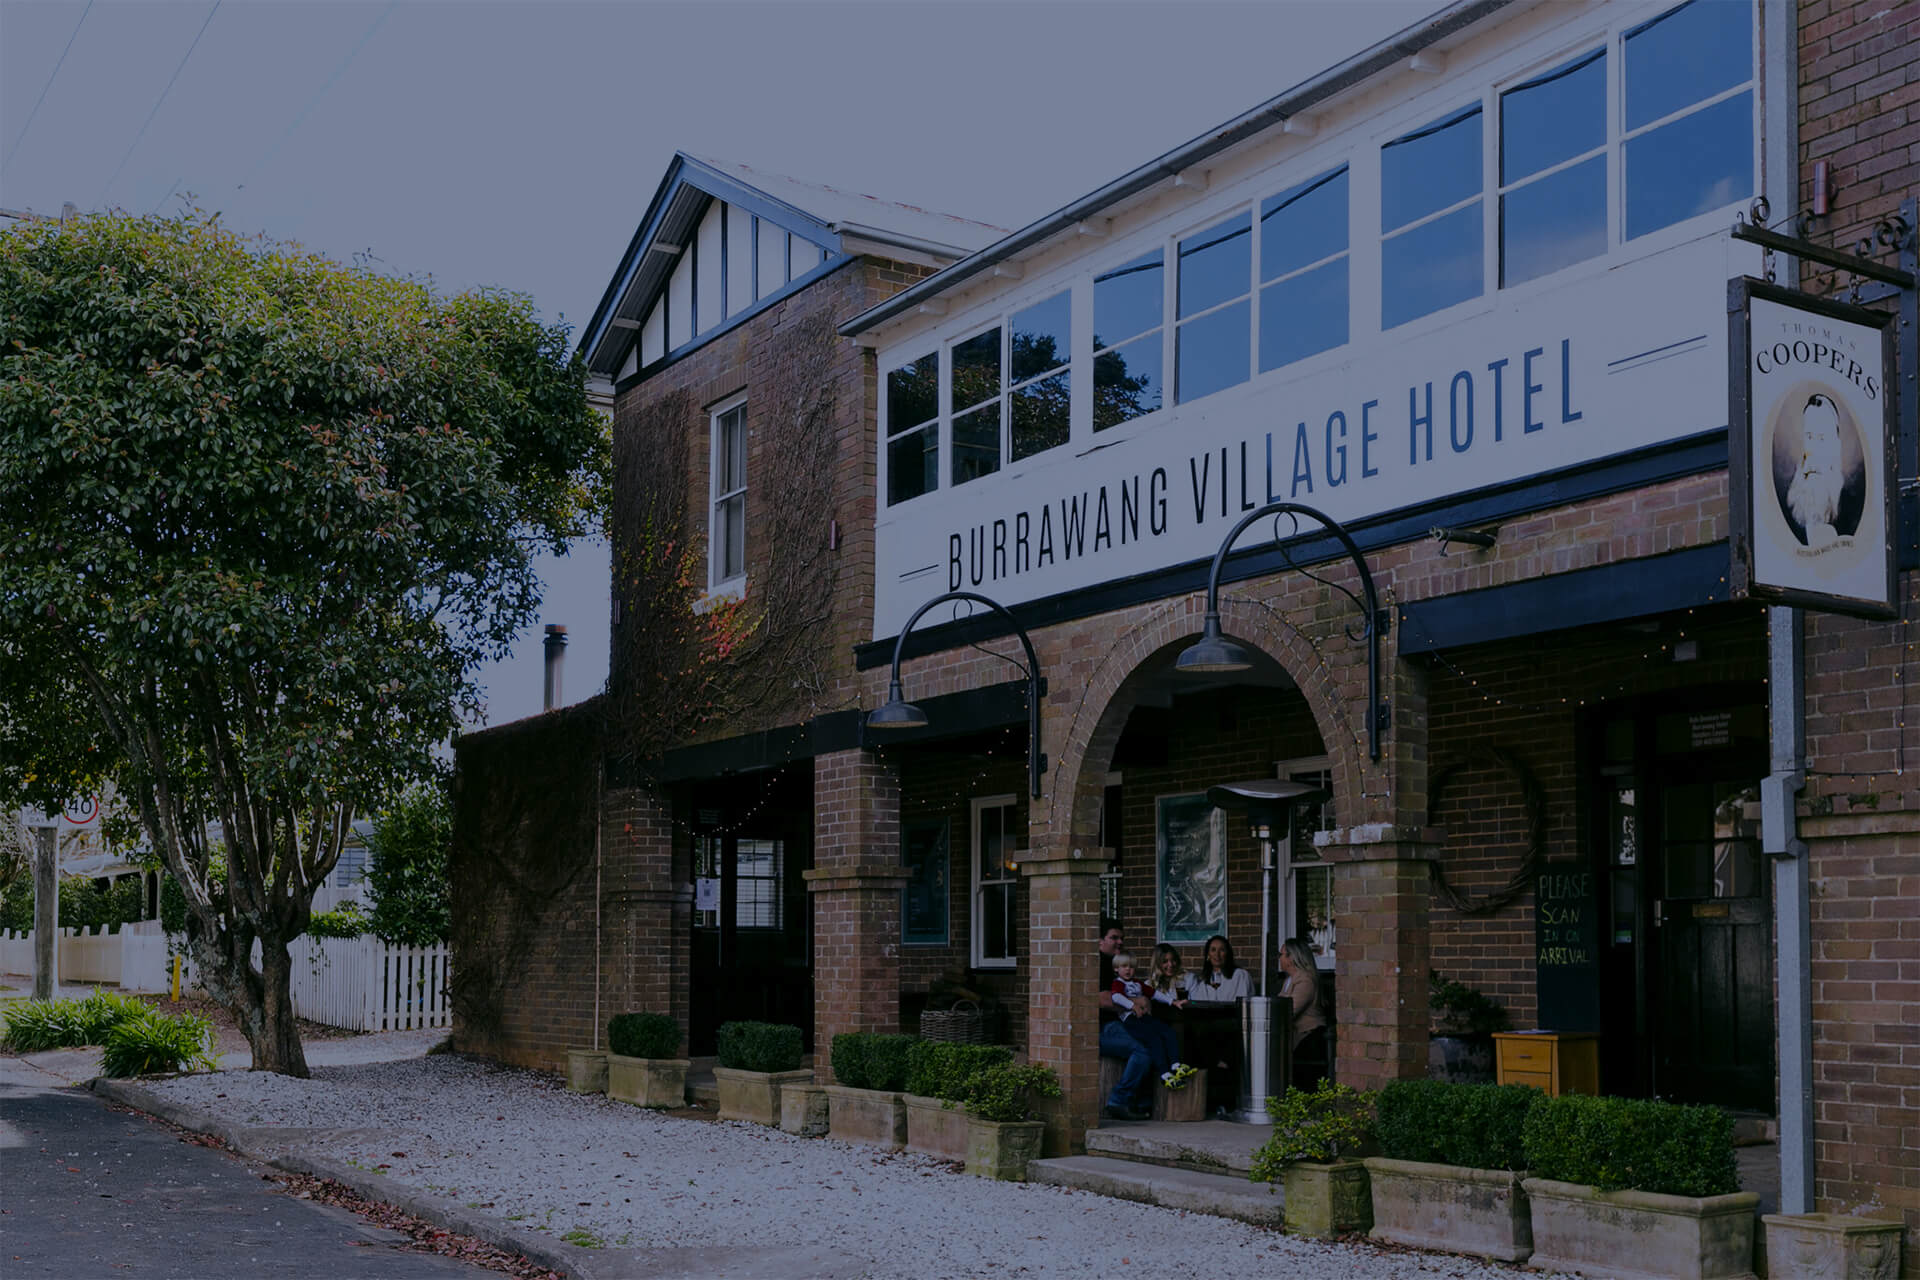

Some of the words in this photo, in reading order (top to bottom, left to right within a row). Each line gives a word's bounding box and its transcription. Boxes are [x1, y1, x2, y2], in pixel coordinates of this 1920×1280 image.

[1782, 322, 1856, 351] THOMAS
[1756, 340, 1879, 401] COOPERS
[950, 467, 1167, 592] BURRAWANG
[1190, 399, 1379, 524] VILLAGE
[1409, 338, 1583, 465] HOTEL
[68, 799, 92, 815] 40
[1539, 872, 1590, 899] PLEASE
[1541, 902, 1580, 925] SCAN
[1538, 947, 1590, 965] ARRIVAL
